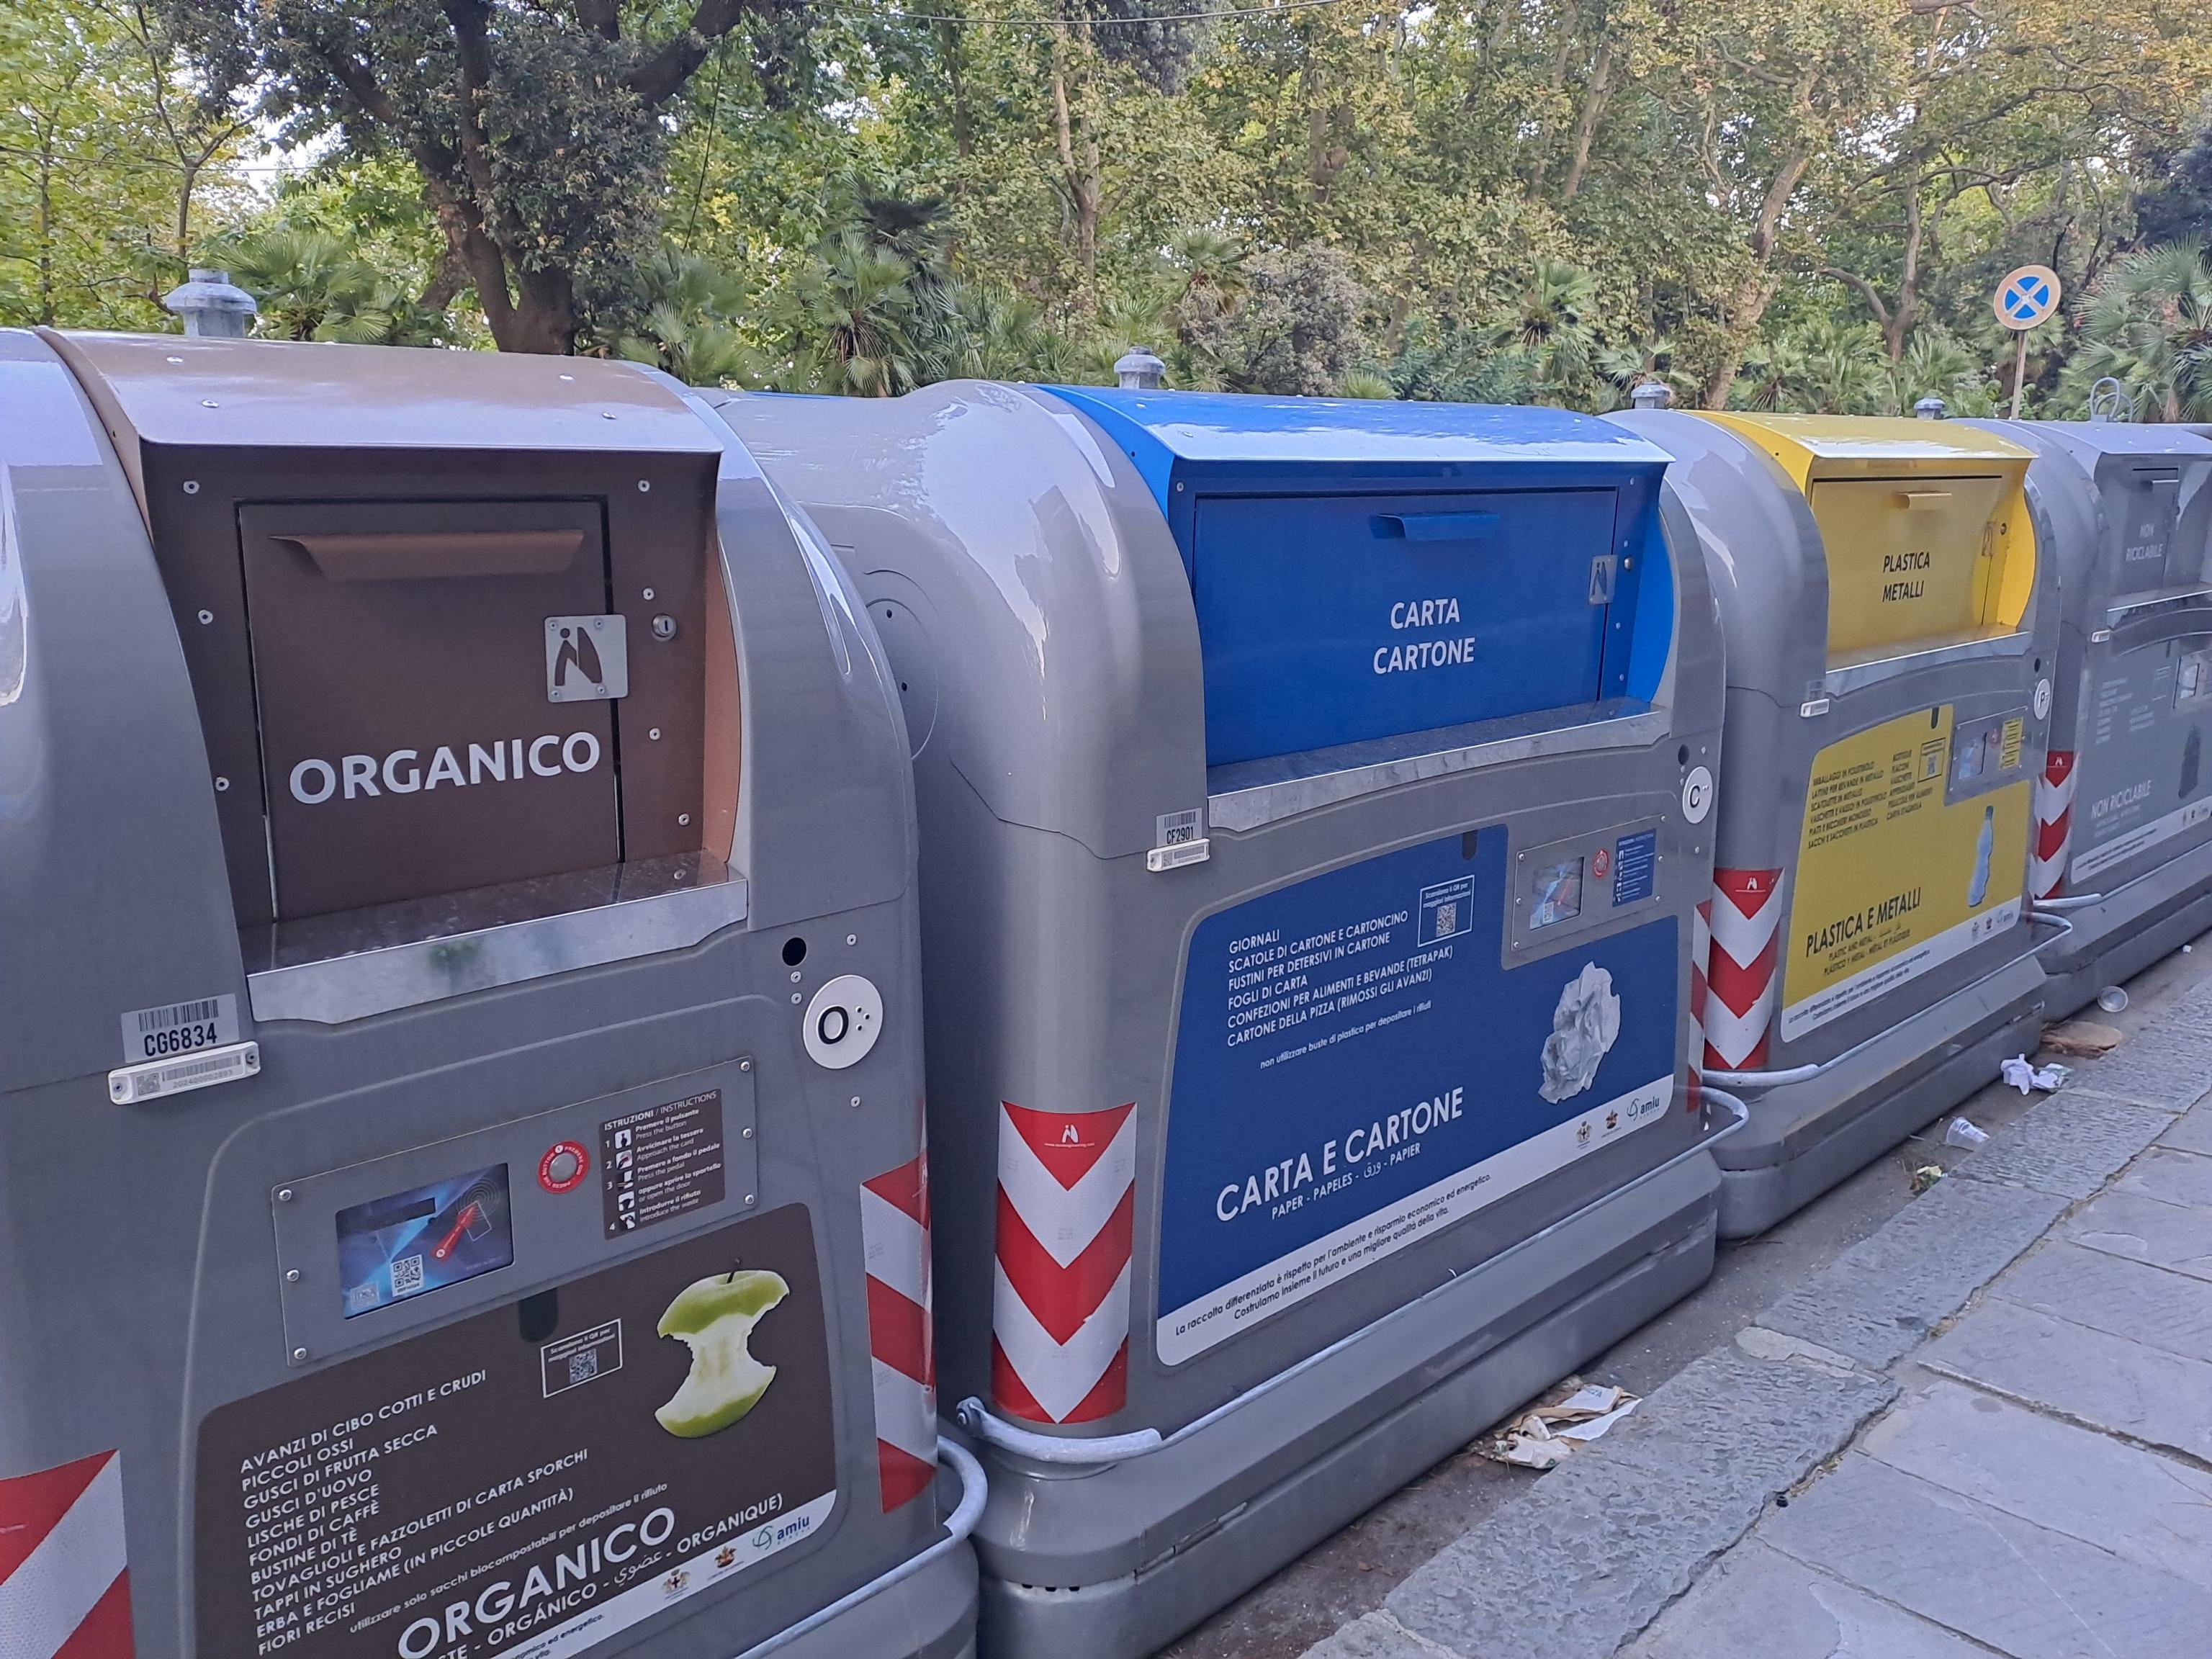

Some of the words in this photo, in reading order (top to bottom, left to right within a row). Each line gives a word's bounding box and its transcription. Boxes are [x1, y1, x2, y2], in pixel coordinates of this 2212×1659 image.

[1881, 580, 1924, 603] METALLI
[1883, 552, 1930, 573] PLASTICA
[1390, 598, 1460, 629] CARTA
[1373, 637, 1475, 674] CARTONE
[289, 732, 600, 804] ORGANICO
[1166, 825, 1193, 845] CF2901
[1228, 948, 1274, 973] SCATOLE
[1277, 945, 1287, 958] DI
[1290, 930, 1336, 954] CARTONE
[1338, 928, 1344, 940] E
[1346, 910, 1408, 938] CARTONCINO
[1229, 929, 1280, 953] GIORNALI
[1806, 912, 1863, 958] PLASTICA
[1866, 907, 1874, 930] E
[1876, 886, 1921, 925] METALLI
[1228, 969, 1264, 992] FUSTINI
[1267, 963, 1285, 979] PER
[1287, 948, 1332, 973] DETERSIVI
[1334, 945, 1344, 958] IN
[1346, 931, 1390, 954] CARTONE
[1228, 997, 1290, 1028] CONFEZIONI
[1293, 991, 1310, 1007] PER
[1312, 976, 1354, 1000] ALIMENTI
[1356, 974, 1362, 986] E
[1364, 960, 1405, 984] BEVANDE
[1406, 945, 1452, 972] (TETRAPAK)
[1228, 989, 1259, 1010] FOGLI
[1262, 985, 1272, 999] DI
[1274, 974, 1308, 994] CARTA
[143, 1022, 217, 1056] CG6834
[1227, 1020, 1276, 1046] CARTONE
[1279, 1010, 1307, 1029] DELLA
[1310, 1000, 1335, 1019] PIZZA
[1337, 986, 1377, 1012] (RIMOSSI
[1380, 980, 1394, 994] GLI
[1395, 968, 1431, 989] AVANZI)
[1260, 1058, 1274, 1069] non
[1276, 1046, 1307, 1063] utilizzare
[1308, 1038, 1328, 1051] buste
[1328, 1033, 1336, 1043] di
[1337, 1025, 1364, 1043] plastica
[1364, 1021, 1377, 1033] per
[1377, 1009, 1412, 1026] depositare
[1413, 1005, 1416, 1014] i
[1416, 1000, 1431, 1012] rifiuti
[604, 1110, 653, 1130] ISTRUZIONI
[660, 1090, 716, 1113] INSTRUCTIONS
[1216, 1152, 1313, 1221] CARTA
[1323, 1140, 1336, 1175] E
[1345, 1087, 1463, 1163] CARTONE
[1272, 1195, 1303, 1220] PAPER
[1313, 1172, 1352, 1200] PAPELES
[1364, 1161, 1381, 1178] ورق
[1390, 1142, 1420, 1166] PAPIER
[1176, 1325, 1185, 1336] La
[1187, 1305, 1223, 1330] raccolta
[1225, 1280, 1274, 1310] differenziata
[1284, 1261, 1311, 1280] rispetto
[1313, 1254, 1326, 1268] per
[1328, 1234, 1366, 1259] l'ambiente
[1374, 1215, 1406, 1236] risparmio
[1407, 1196, 1444, 1219] economico
[1446, 1189, 1455, 1200] ed
[1456, 1174, 1491, 1195] energetico.
[1234, 1291, 1280, 1319] Costruiamo
[1282, 1275, 1311, 1296] insieme
[1313, 1269, 1317, 1280] il
[1318, 1261, 1339, 1277] futuro
[1348, 1250, 1362, 1262] una
[1363, 1235, 1391, 1254] migliore
[1393, 1223, 1416, 1240] qualità
[1417, 1213, 1434, 1227] della
[1436, 1207, 1449, 1218] vita.
[240, 1437, 305, 1473] AVANZI
[310, 1429, 327, 1446] DI
[332, 1413, 373, 1437] CIBO
[378, 1393, 422, 1419] COTTI
[427, 1388, 436, 1401] E
[439, 1370, 485, 1395] CRUDI
[242, 1454, 312, 1491] PICCOLI
[317, 1437, 353, 1461] OSSI
[243, 1478, 297, 1509] GUSCI
[303, 1470, 319, 1486] DI
[325, 1447, 379, 1478] FRUTTA
[384, 1424, 437, 1454] SECCA
[245, 1497, 300, 1528] GUSCI
[305, 1469, 372, 1505] D'UOVO
[247, 1514, 305, 1548] LISCHE
[309, 1506, 325, 1523] DI
[331, 1483, 379, 1514] PESCE
[252, 1549, 352, 1602] TOVAGLIOLI
[357, 1543, 366, 1557] E
[370, 1506, 451, 1551] FAZZOLETTI
[456, 1498, 471, 1514] DI
[475, 1477, 523, 1504] CARTA
[527, 1448, 587, 1483] SPORCHI
[777, 1516, 809, 1540] amiu
[249, 1534, 302, 1566] FONDI
[307, 1524, 324, 1542] DI
[329, 1500, 379, 1532] CAFFÈ
[251, 1546, 315, 1585] BUSTINE
[320, 1537, 336, 1555] DI
[340, 1527, 357, 1545] TÈ
[256, 1611, 298, 1638] ERBA
[303, 1603, 312, 1617] E
[317, 1563, 400, 1610] FOGLIAME
[403, 1552, 426, 1574] (IN
[430, 1521, 494, 1560] PICCOLE
[498, 1487, 572, 1528] QUANTITÀ)
[350, 1604, 401, 1633] utilizzare
[404, 1593, 427, 1608] solo
[430, 1571, 468, 1596] sacchi
[470, 1531, 557, 1577] biocompostabili
[559, 1524, 576, 1539] per
[578, 1499, 631, 1527] depositare
[633, 1493, 639, 1503] il
[641, 1483, 667, 1500] rifiuto
[253, 1591, 299, 1620] TAPPI
[304, 1581, 320, 1599] IN
[325, 1546, 401, 1588] SUGHERO
[398, 1507, 675, 1659] ORGANICO
[487, 1583, 597, 1645] ORGÁNICO
[614, 1552, 662, 1586] عضوي
[677, 1493, 782, 1553] ORGANIQUE)
[258, 1627, 300, 1656] FIORI
[306, 1601, 354, 1634] RECISI
